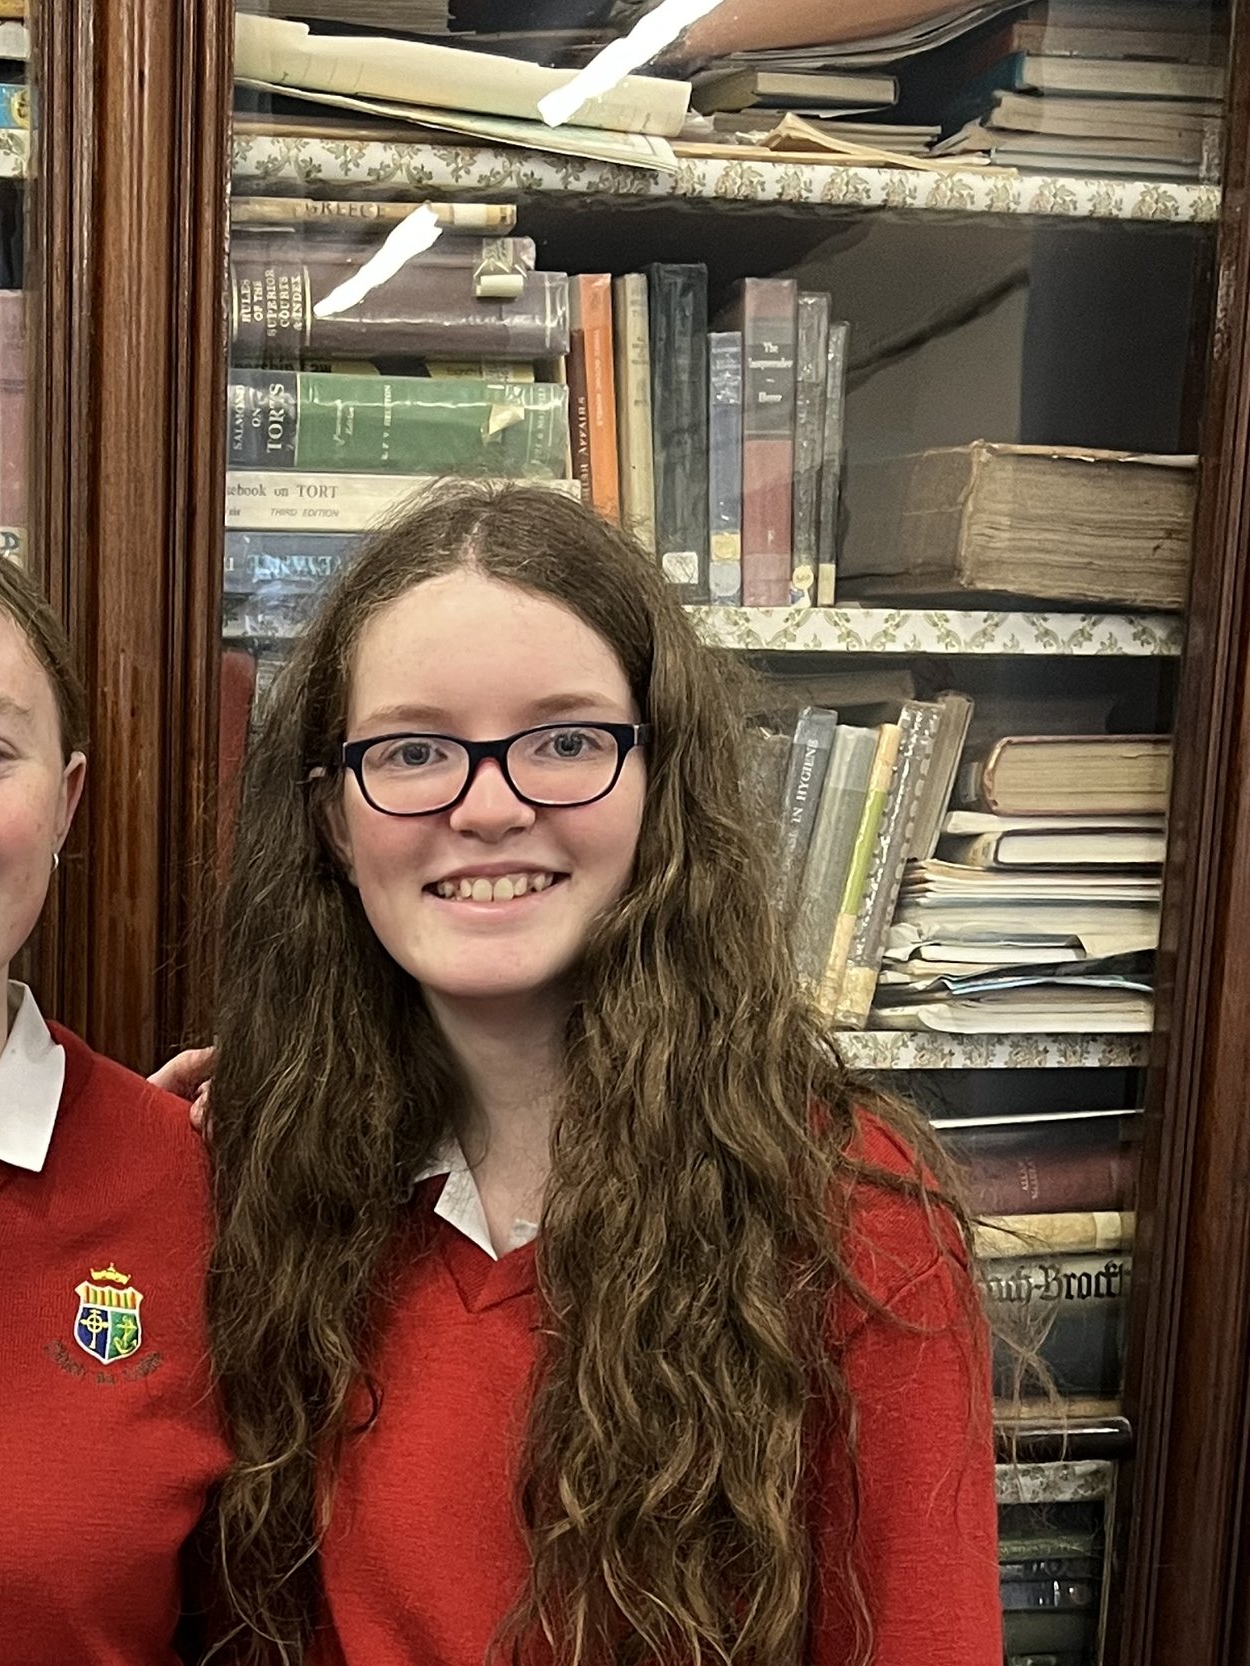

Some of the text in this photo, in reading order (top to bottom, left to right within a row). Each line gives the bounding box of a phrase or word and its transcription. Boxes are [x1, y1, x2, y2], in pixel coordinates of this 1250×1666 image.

[306, 202, 386, 218] GREECE
[241, 279, 252, 323] RULES
[253, 280, 264, 322] OF THE
[265, 268, 277, 337] SUPERIOR
[278, 275, 291, 328] COURTS
[291, 274, 303, 317] INDEX
[232, 384, 246, 451] SALMOND
[251, 407, 262, 428] ON
[266, 383, 286, 454] TORTS
[270, 507, 340, 518] THIRD EDITION
[274, 486, 289, 497] on
[296, 484, 339, 499] TORT
[791, 738, 820, 826] IN HYGIENE
